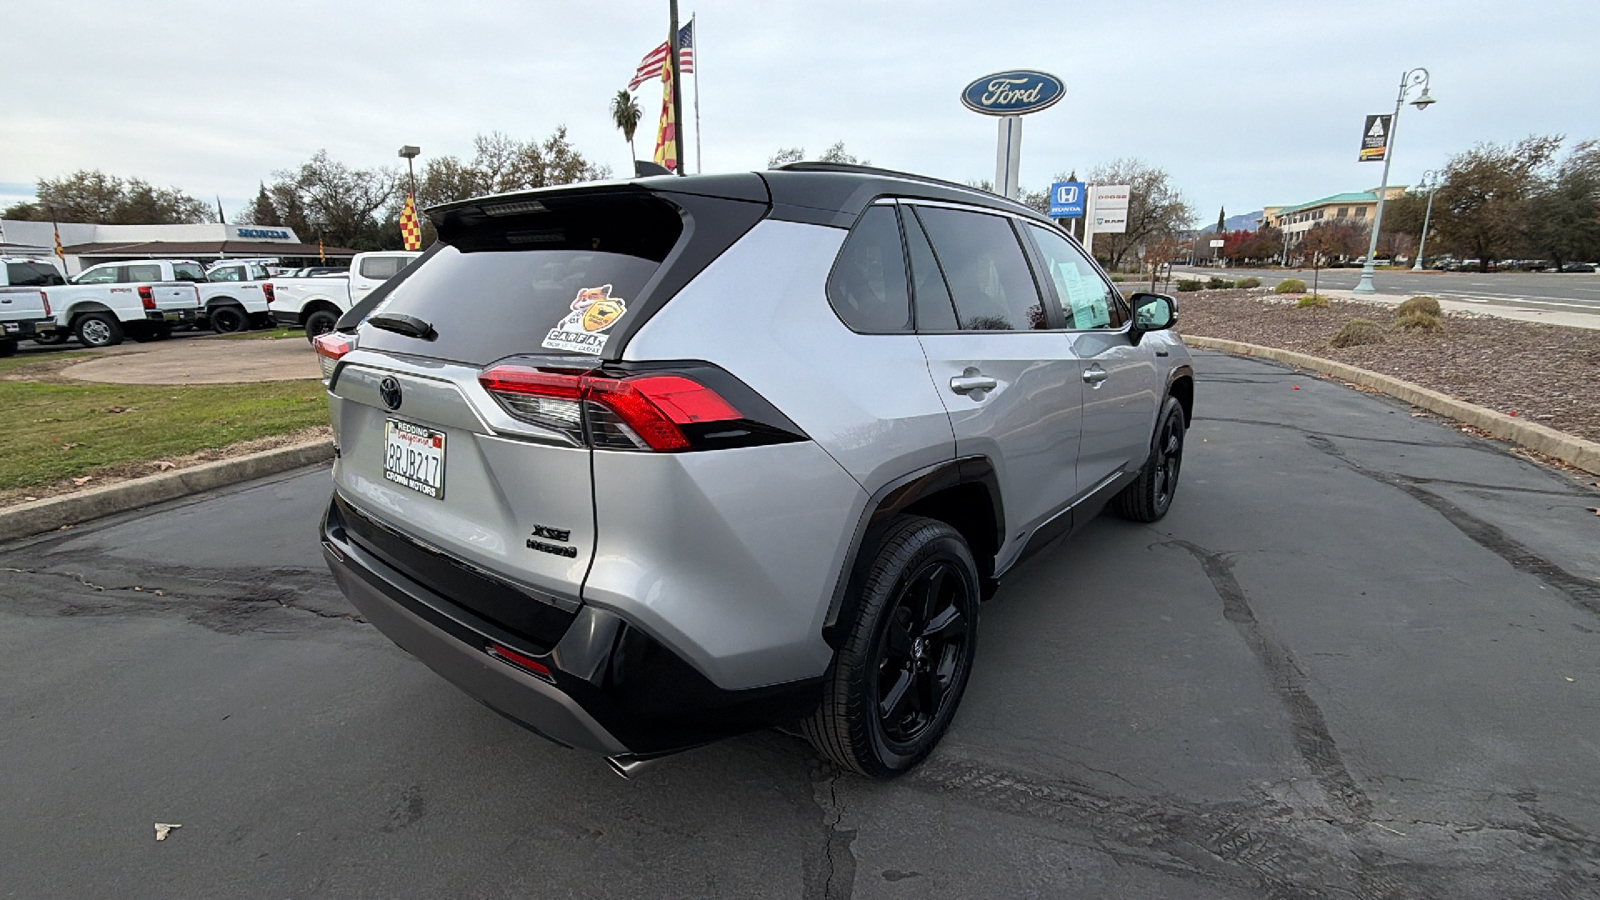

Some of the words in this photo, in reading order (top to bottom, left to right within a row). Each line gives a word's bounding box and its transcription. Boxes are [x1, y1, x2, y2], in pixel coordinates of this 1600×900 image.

[982, 78, 1043, 105] Ford
[236, 228, 290, 239] HONDA
[549, 330, 604, 347] CARFAX
[398, 422, 428, 436] REDDING
[388, 443, 439, 486] 8RJB217
[387, 471, 408, 486] CROWN
[409, 479, 436, 497] MOTORS
[531, 524, 571, 542] XSE
